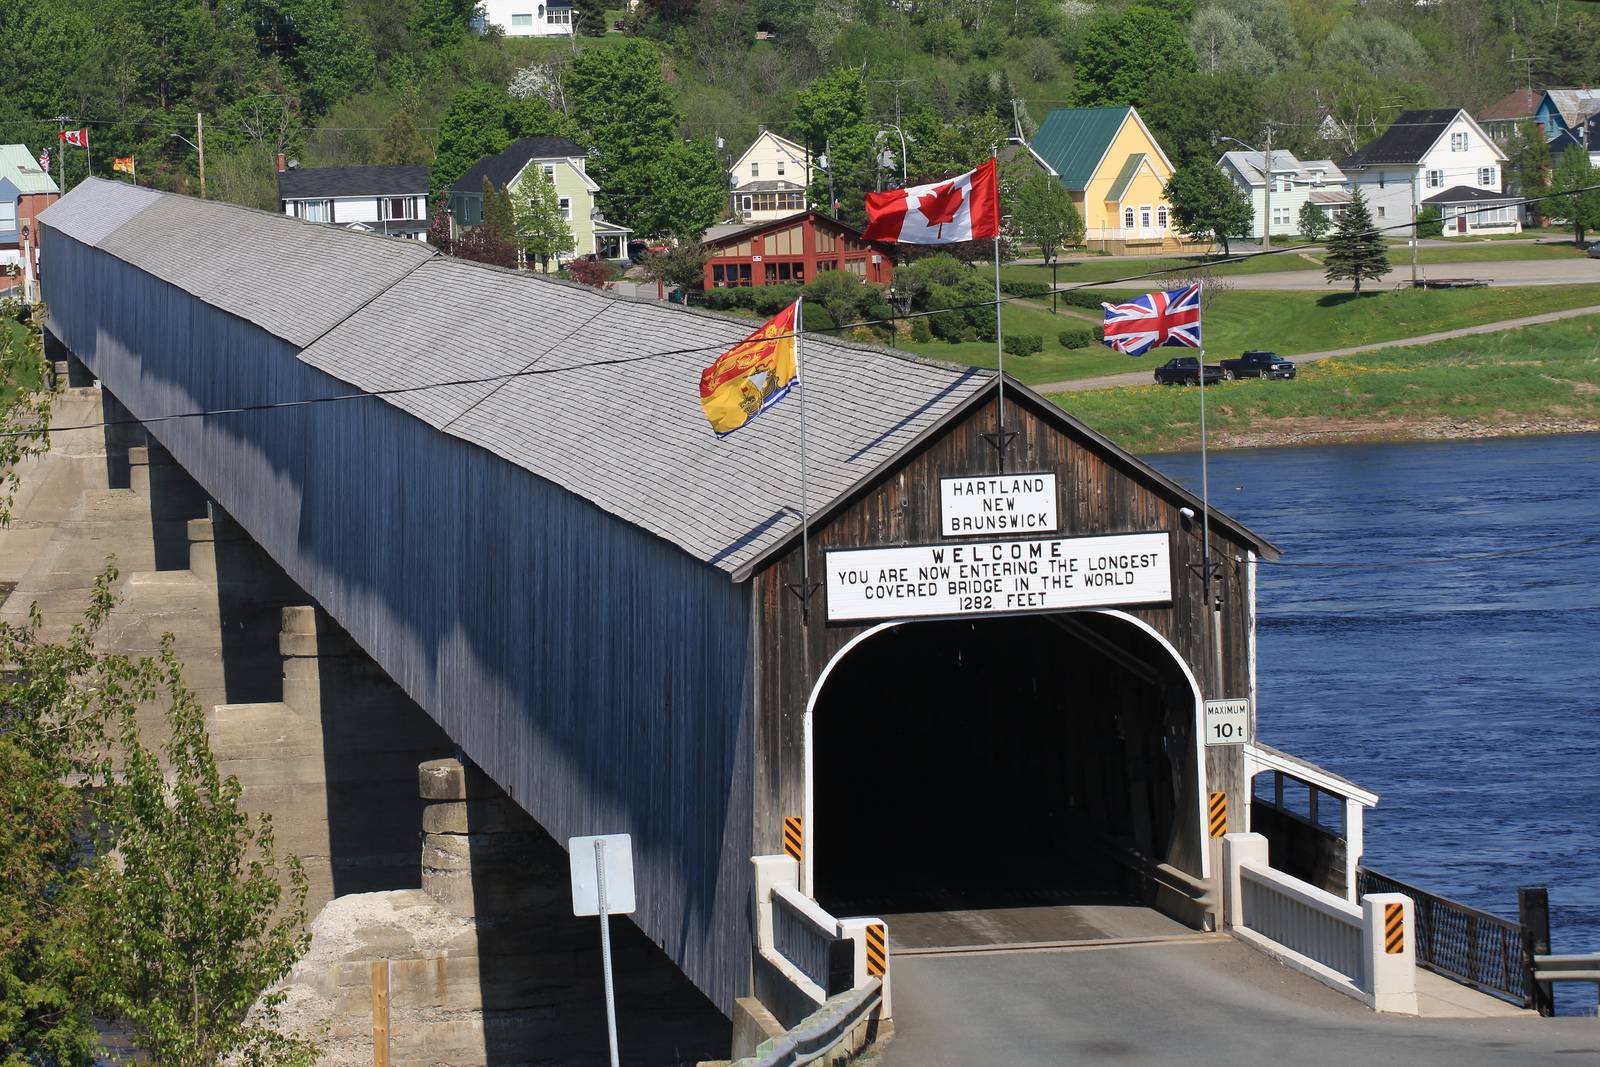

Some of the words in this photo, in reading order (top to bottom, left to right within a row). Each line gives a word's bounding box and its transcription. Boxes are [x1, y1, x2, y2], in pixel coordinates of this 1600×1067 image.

[953, 479, 1044, 496] HARTLAND
[983, 497, 1015, 512] NEW
[952, 513, 1047, 531] BRUNSWICK
[932, 542, 1062, 564] WELCOME
[838, 570, 868, 584] YOU
[878, 568, 908, 583] ARE
[919, 566, 950, 581] NOW
[960, 561, 1038, 578] ENTERING
[1049, 558, 1078, 573] THE
[1088, 553, 1158, 571] LONGEST
[865, 582, 937, 599] COVERED
[949, 579, 1002, 595] BRIDGE
[1015, 577, 1029, 591] IN
[1041, 575, 1073, 589] THE
[1084, 571, 1134, 587] WORLD
[959, 595, 992, 610] 1282
[1007, 592, 1047, 607] FEET
[1207, 705, 1246, 715] MAXIMUM
[1213, 723, 1233, 738] 10
[1237, 725, 1243, 737] t
